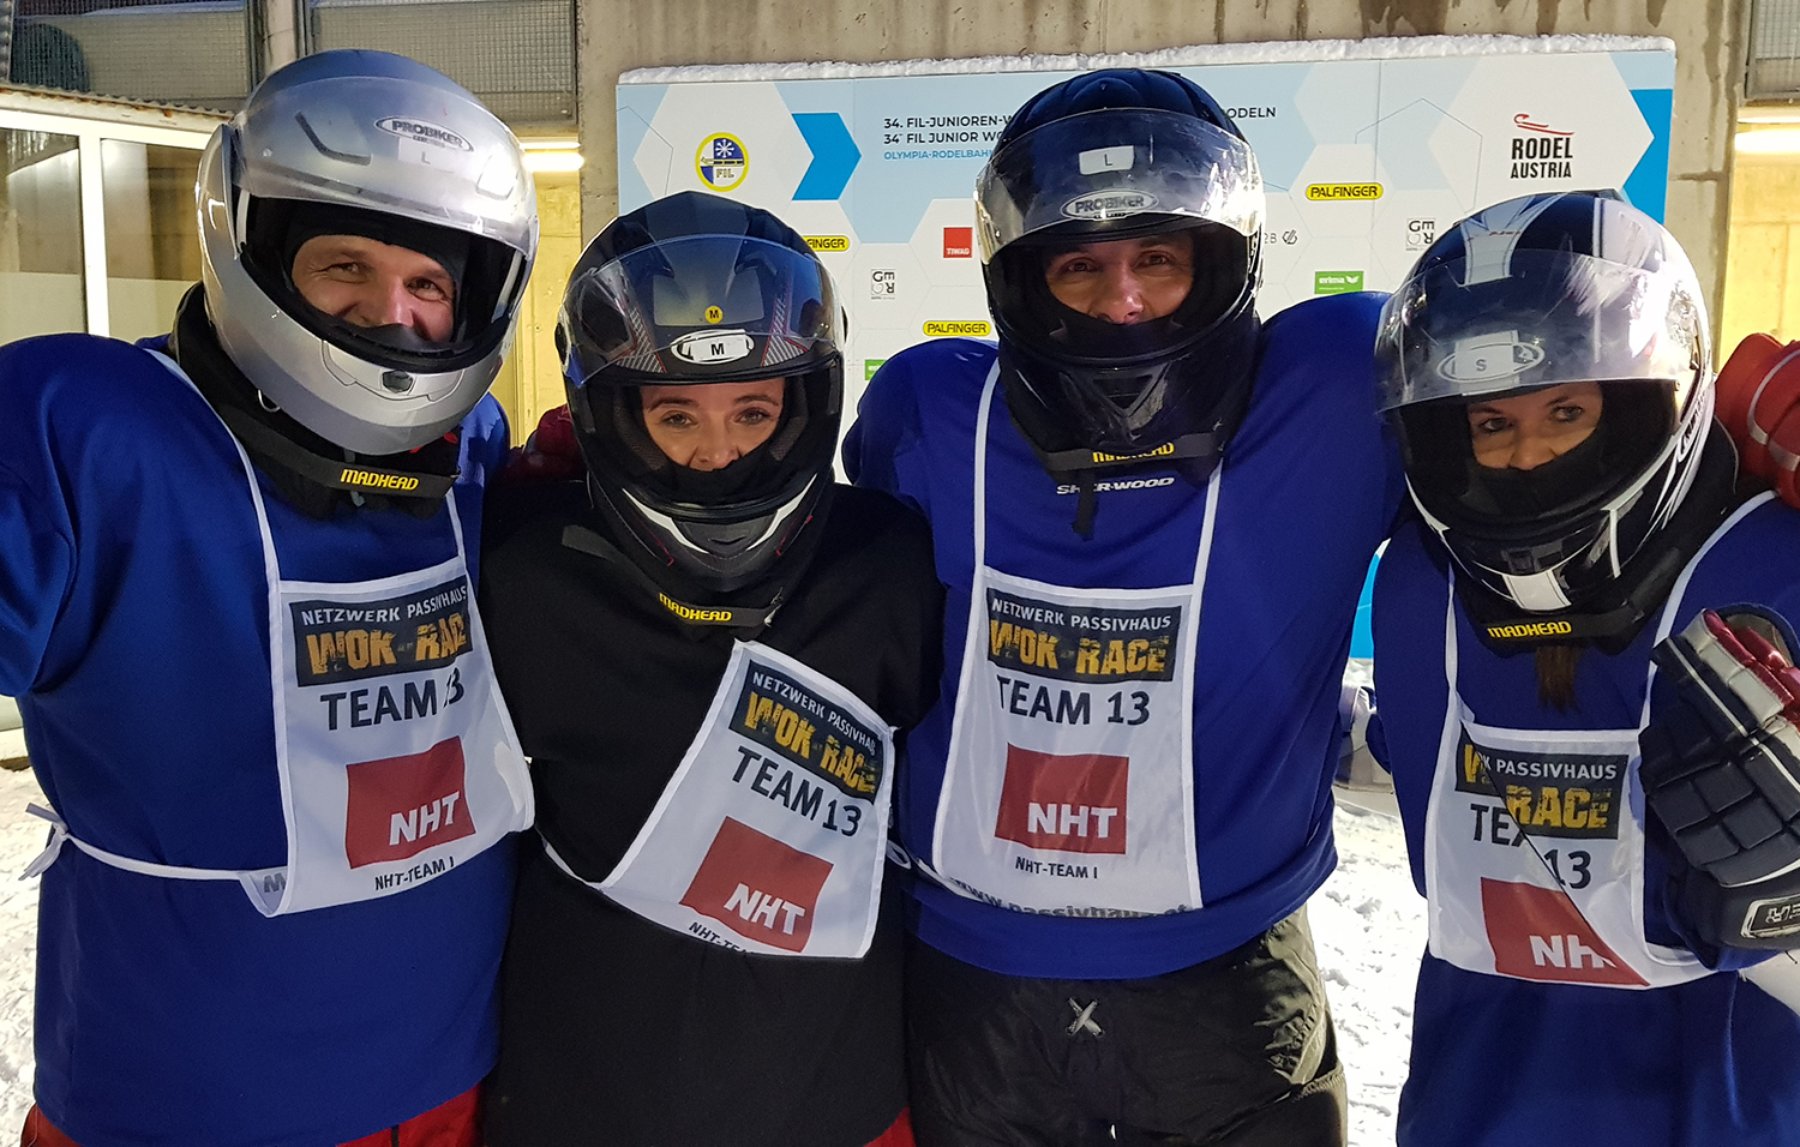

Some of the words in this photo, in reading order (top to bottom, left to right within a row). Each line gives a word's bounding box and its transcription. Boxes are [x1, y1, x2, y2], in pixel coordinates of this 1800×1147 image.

[884, 118, 903, 129] 34.
[1227, 107, 1276, 119] ODELN
[392, 120, 463, 148] PROBIKER
[906, 133, 925, 144] FIL
[929, 132, 978, 144] JUNIOR
[421, 151, 431, 165] L
[1104, 153, 1113, 166] L
[1511, 137, 1573, 160] RODEL
[1510, 161, 1572, 179] AUSTRIA
[1310, 185, 1378, 198] PALFINGER
[1075, 195, 1144, 213] PROBIKER
[807, 238, 846, 249] FINGER
[709, 309, 719, 319] M
[927, 323, 987, 334] PALFINGER
[710, 342, 725, 356] M
[1475, 358, 1487, 372] S
[340, 468, 419, 491] MADHEAD
[1056, 477, 1175, 495] SHR-WOOD
[301, 606, 400, 626] NETZWERK
[659, 592, 732, 622] MADHEAD
[991, 598, 1065, 626] NETZWERK
[1070, 615, 1172, 632] PASSIVHAUS
[1487, 621, 1572, 638] MADHEAD
[306, 629, 398, 675] WOK
[990, 619, 1059, 671] WOK
[1075, 635, 1169, 676] RACE
[320, 679, 437, 731] TEAM
[444, 667, 465, 708] 3
[753, 671, 826, 719] NETZWERK
[996, 674, 1091, 726] TEAM
[1107, 690, 1150, 726] 13
[744, 691, 817, 760] WOK
[1496, 758, 1618, 780] PASSIVHAUS
[732, 745, 824, 821] TEAM
[822, 799, 862, 837] 13
[1505, 784, 1613, 829] RACE
[389, 791, 460, 846] NHT
[1027, 802, 1118, 839] NHT
[1470, 803, 1527, 848] TE
[375, 858, 446, 891] NHT-TEAM
[1015, 856, 1088, 879] NHT-TEAM
[723, 882, 806, 936] NHT
[689, 921, 747, 953] NHT-TE
